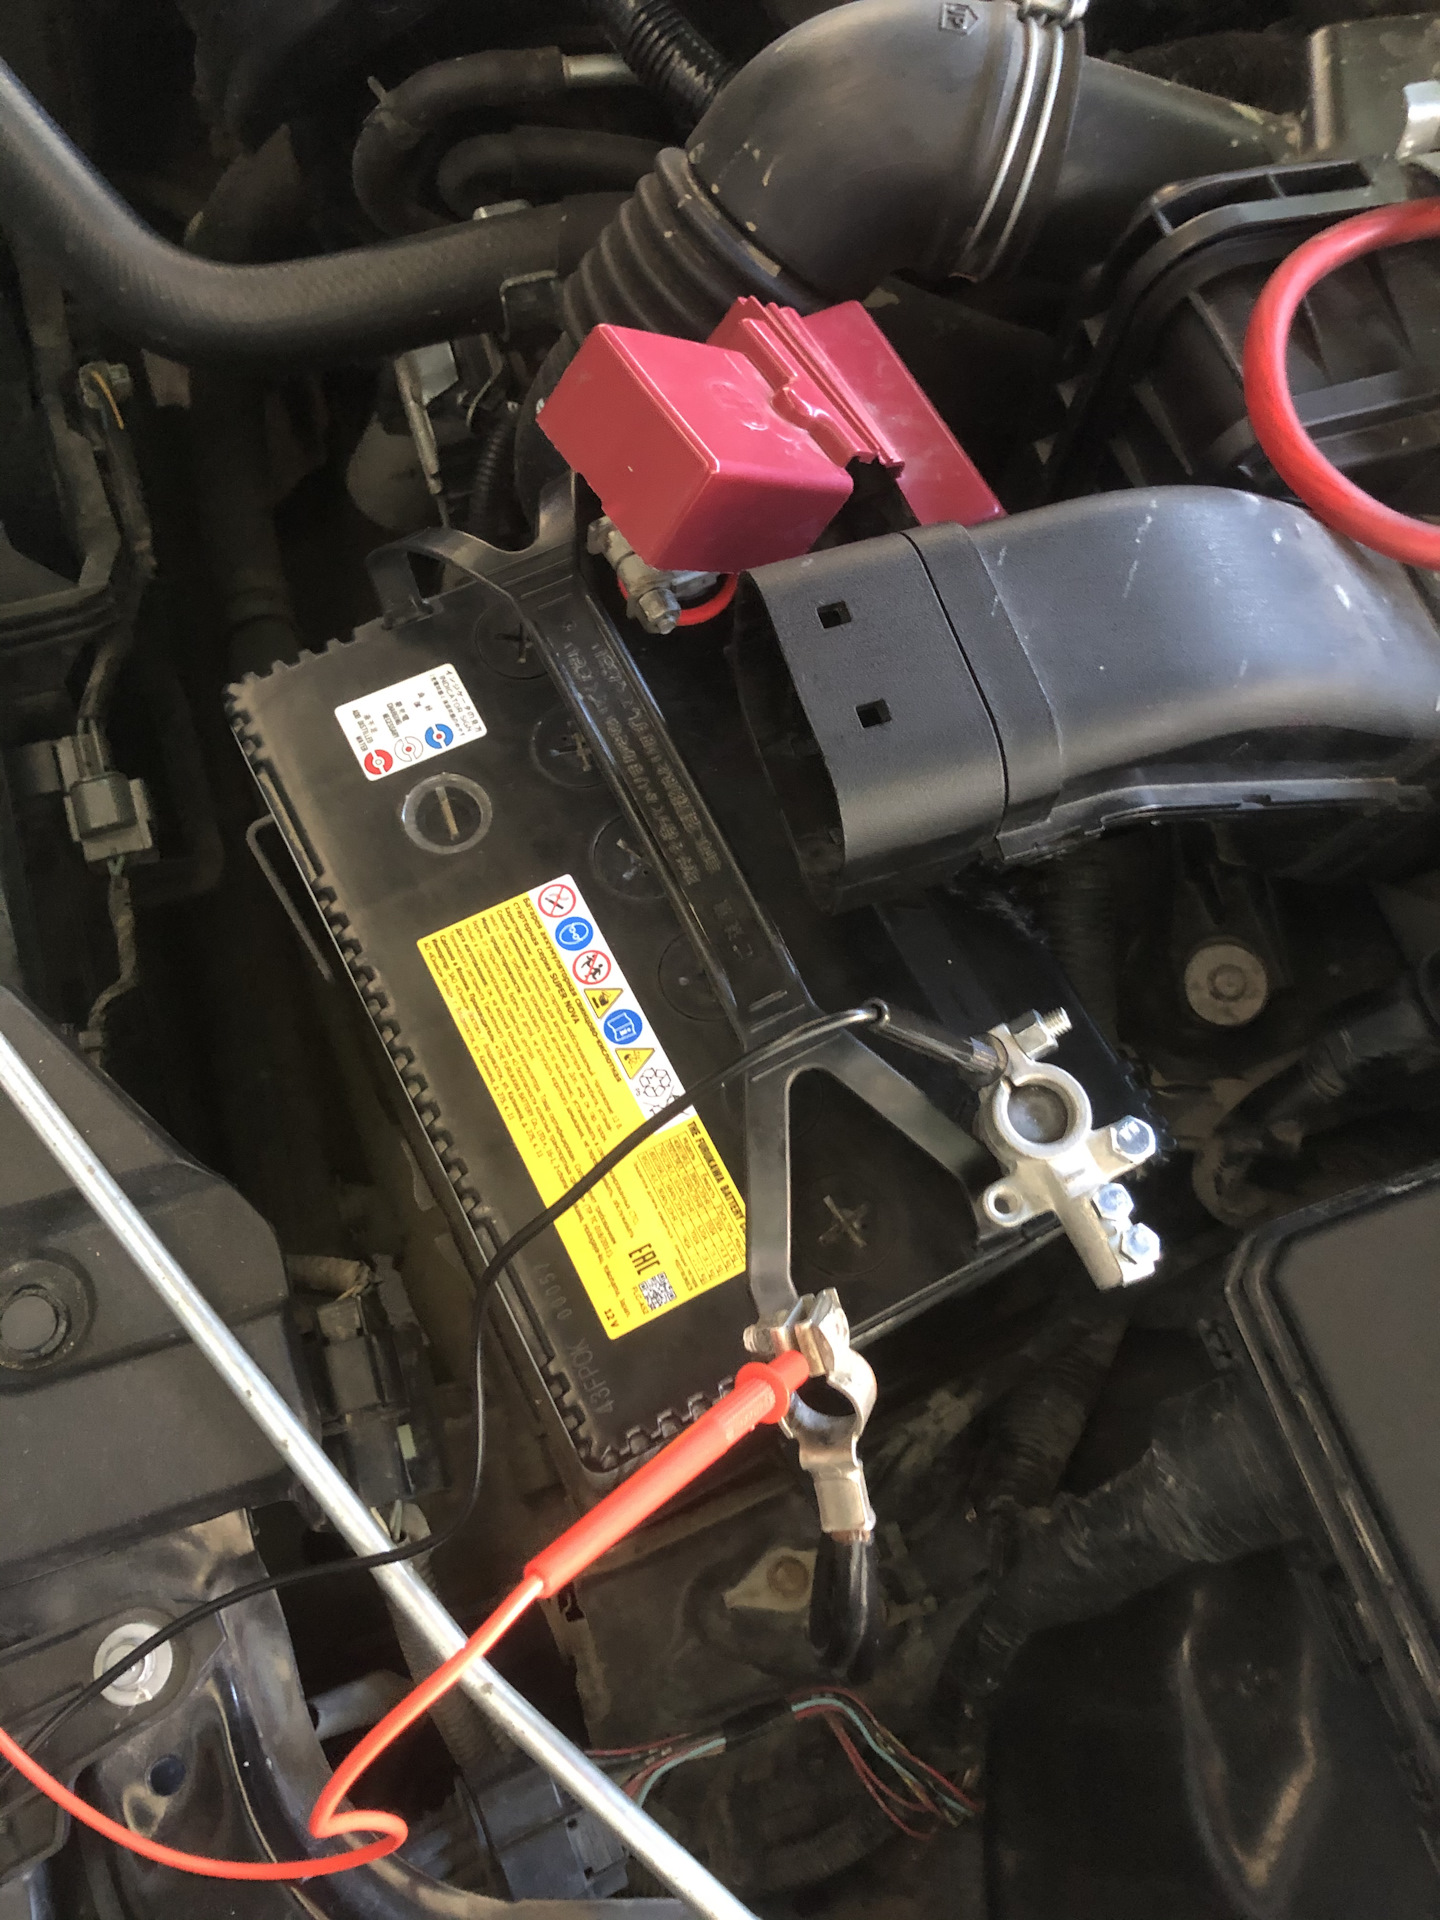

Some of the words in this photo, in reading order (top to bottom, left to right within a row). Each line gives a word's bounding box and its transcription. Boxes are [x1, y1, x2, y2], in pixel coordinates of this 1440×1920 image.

[439, 674, 463, 714] INDICATOR
[459, 714, 472, 732] SIGN
[382, 712, 399, 739] NECESSARY
[355, 734, 368, 752] WATER
[438, 934, 457, 961] Сделано
[455, 926, 467, 943] Дата
[511, 901, 539, 947] стартерная
[535, 947, 552, 972] серии
[549, 972, 568, 999] SUPER
[563, 999, 580, 1024] NOVA
[521, 896, 543, 930] Батарея
[538, 930, 577, 997] аккумуляторная
[573, 997, 621, 1083] свинцово-кислотная
[687, 1121, 700, 1137] THE
[695, 1137, 724, 1183] FURUKAWA
[719, 1184, 744, 1221] BATTERY
[603, 1307, 615, 1320] 12
[609, 1319, 619, 1329] V
